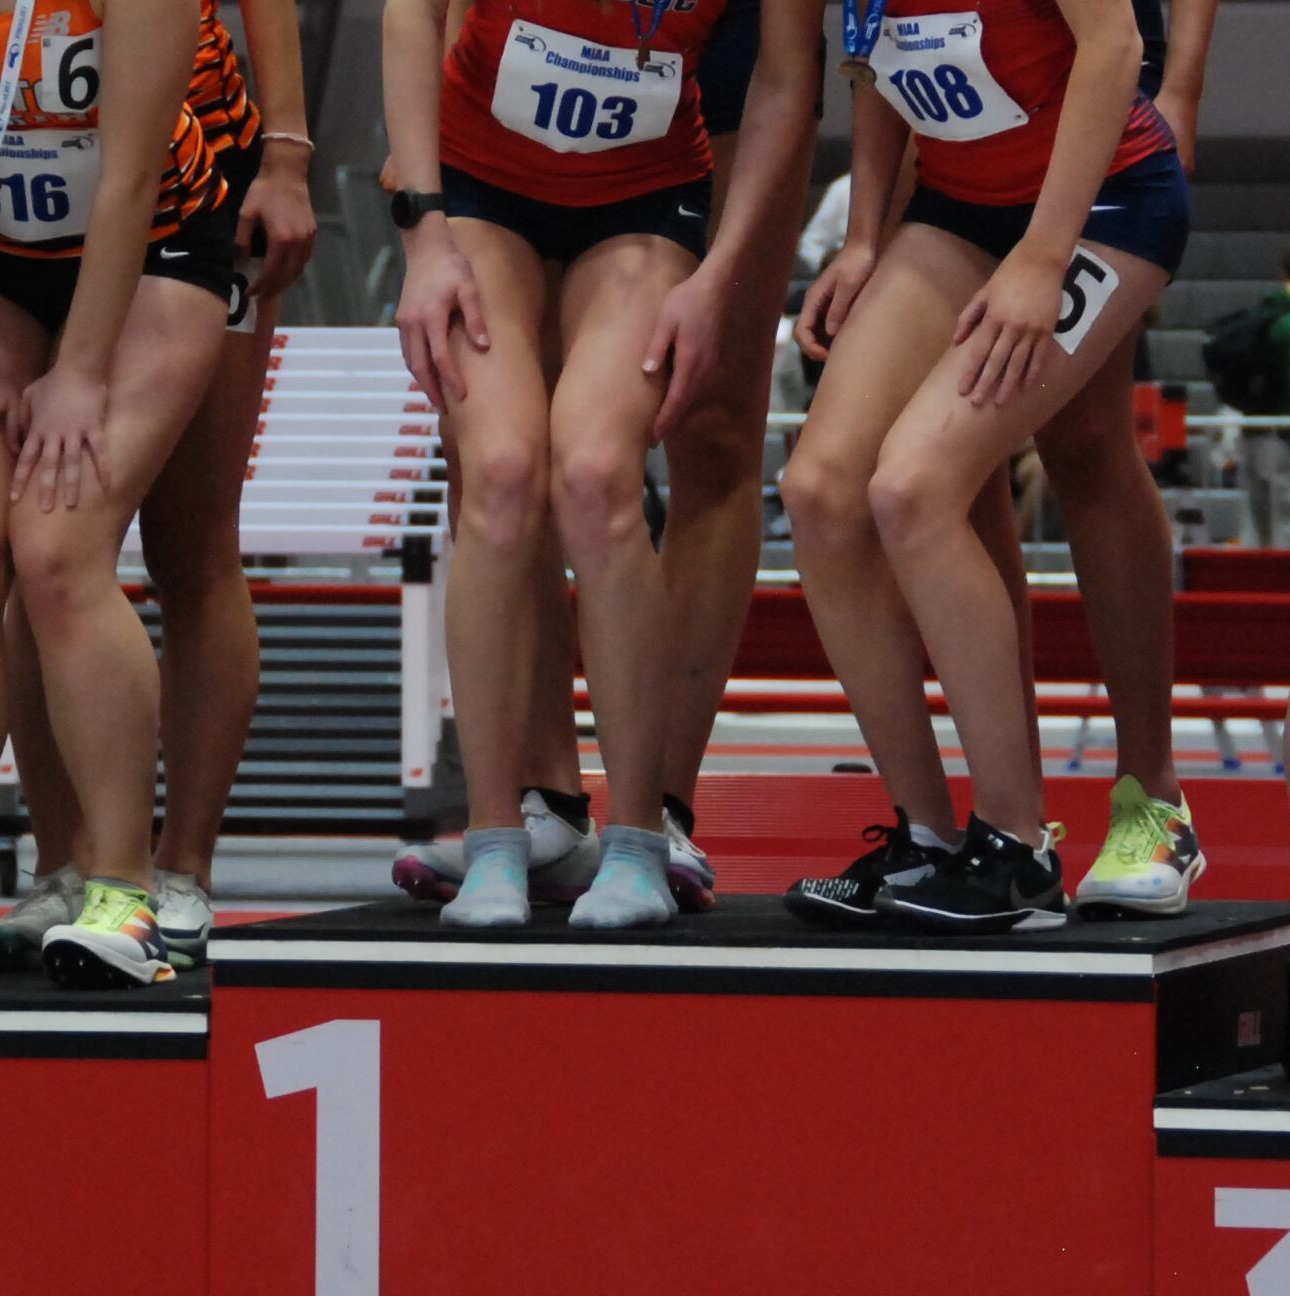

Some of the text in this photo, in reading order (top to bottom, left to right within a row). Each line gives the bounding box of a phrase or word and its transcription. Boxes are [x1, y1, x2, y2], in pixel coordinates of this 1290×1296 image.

[58, 37, 100, 110] 6
[545, 50, 641, 83] Championships
[580, 45, 611, 62] MIAA
[531, 82, 638, 140] 103
[888, 63, 983, 124] 108
[1054, 253, 1107, 334] 5
[254, 1018, 381, 1296] 1
